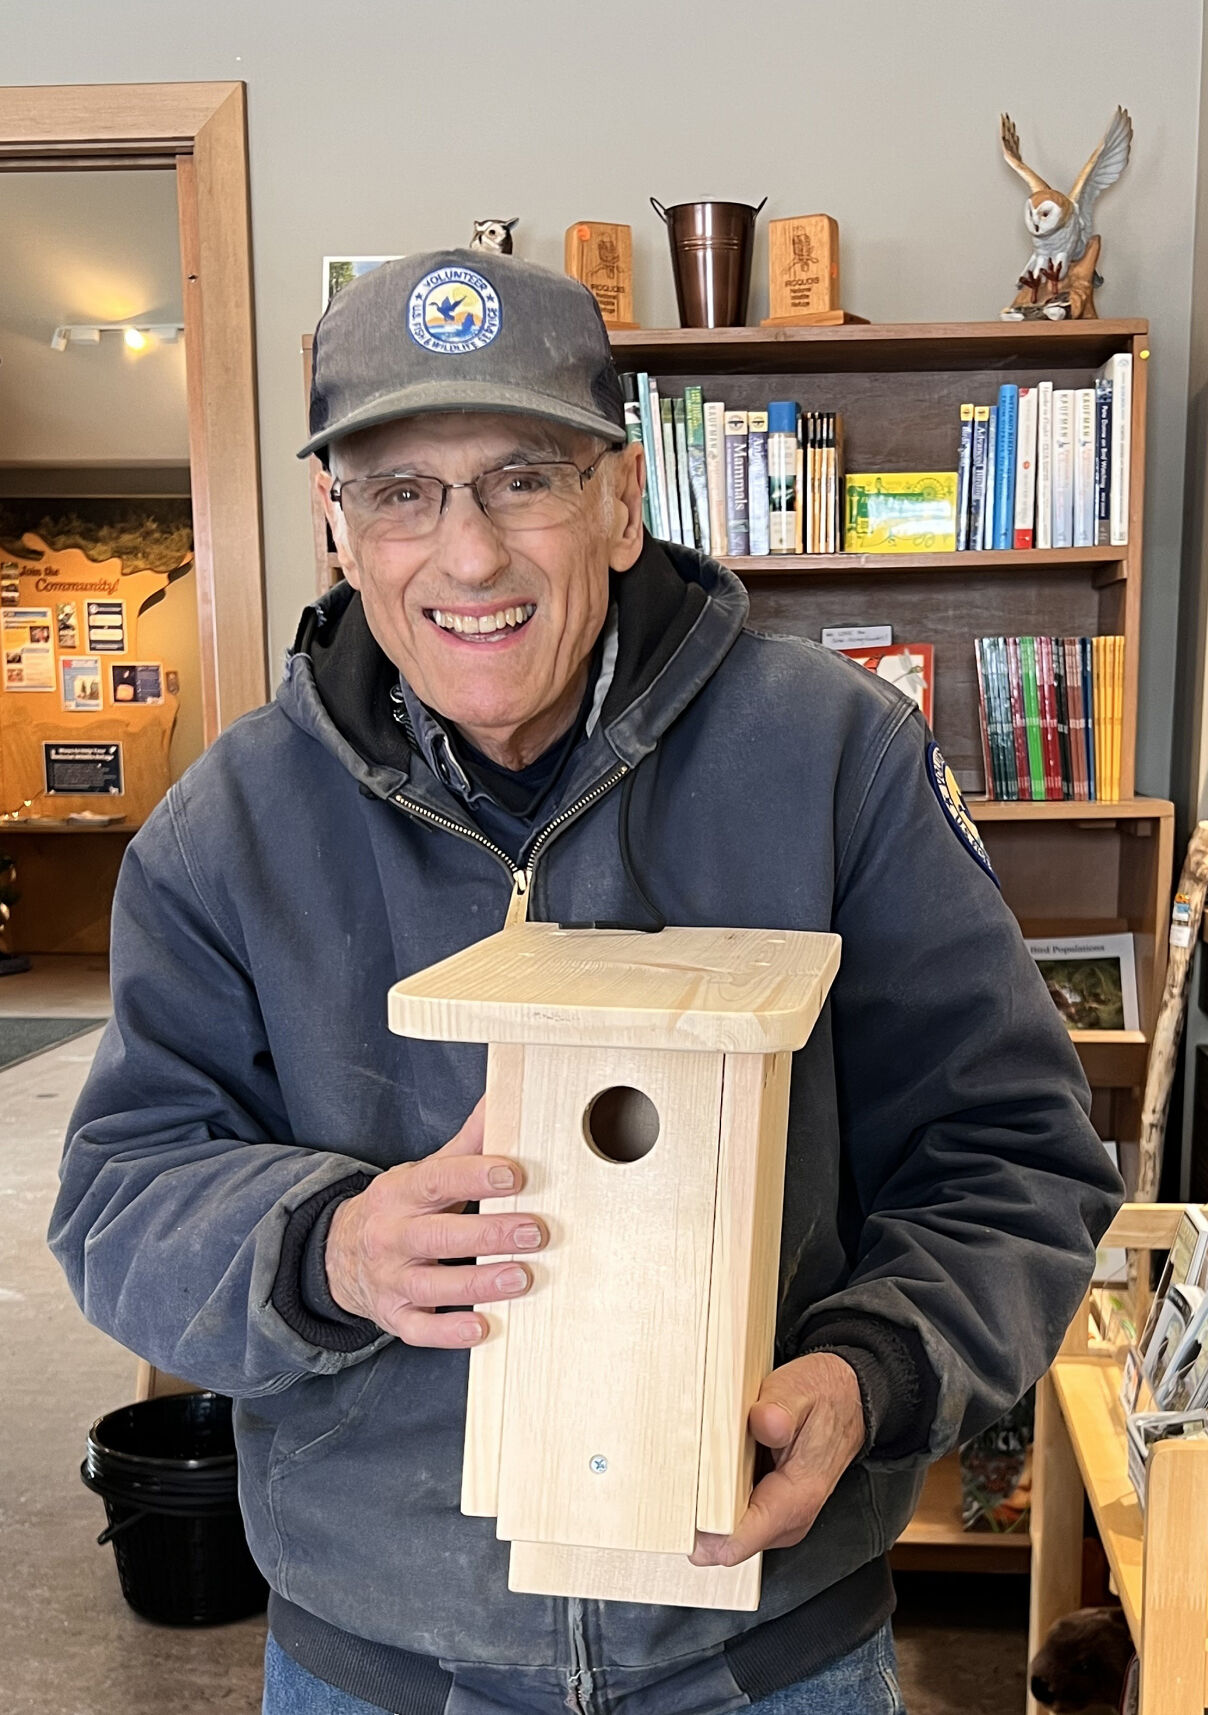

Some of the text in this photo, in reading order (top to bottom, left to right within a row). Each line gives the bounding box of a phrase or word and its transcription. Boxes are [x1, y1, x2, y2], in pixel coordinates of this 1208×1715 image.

[423, 270, 488, 291] VOLUNTEER
[431, 340, 478, 352] WILDLIFE
[478, 307, 498, 344] SERVICE
[1061, 393, 1069, 438] KAUFMAN
[1082, 392, 1091, 437] KAUFMAN
[734, 443, 747, 511] Mammals
[1099, 461, 1108, 488] Watching
[19, 565, 60, 576] Join the
[35, 577, 120, 595] Community!
[1052, 944, 1105, 955] Populations
